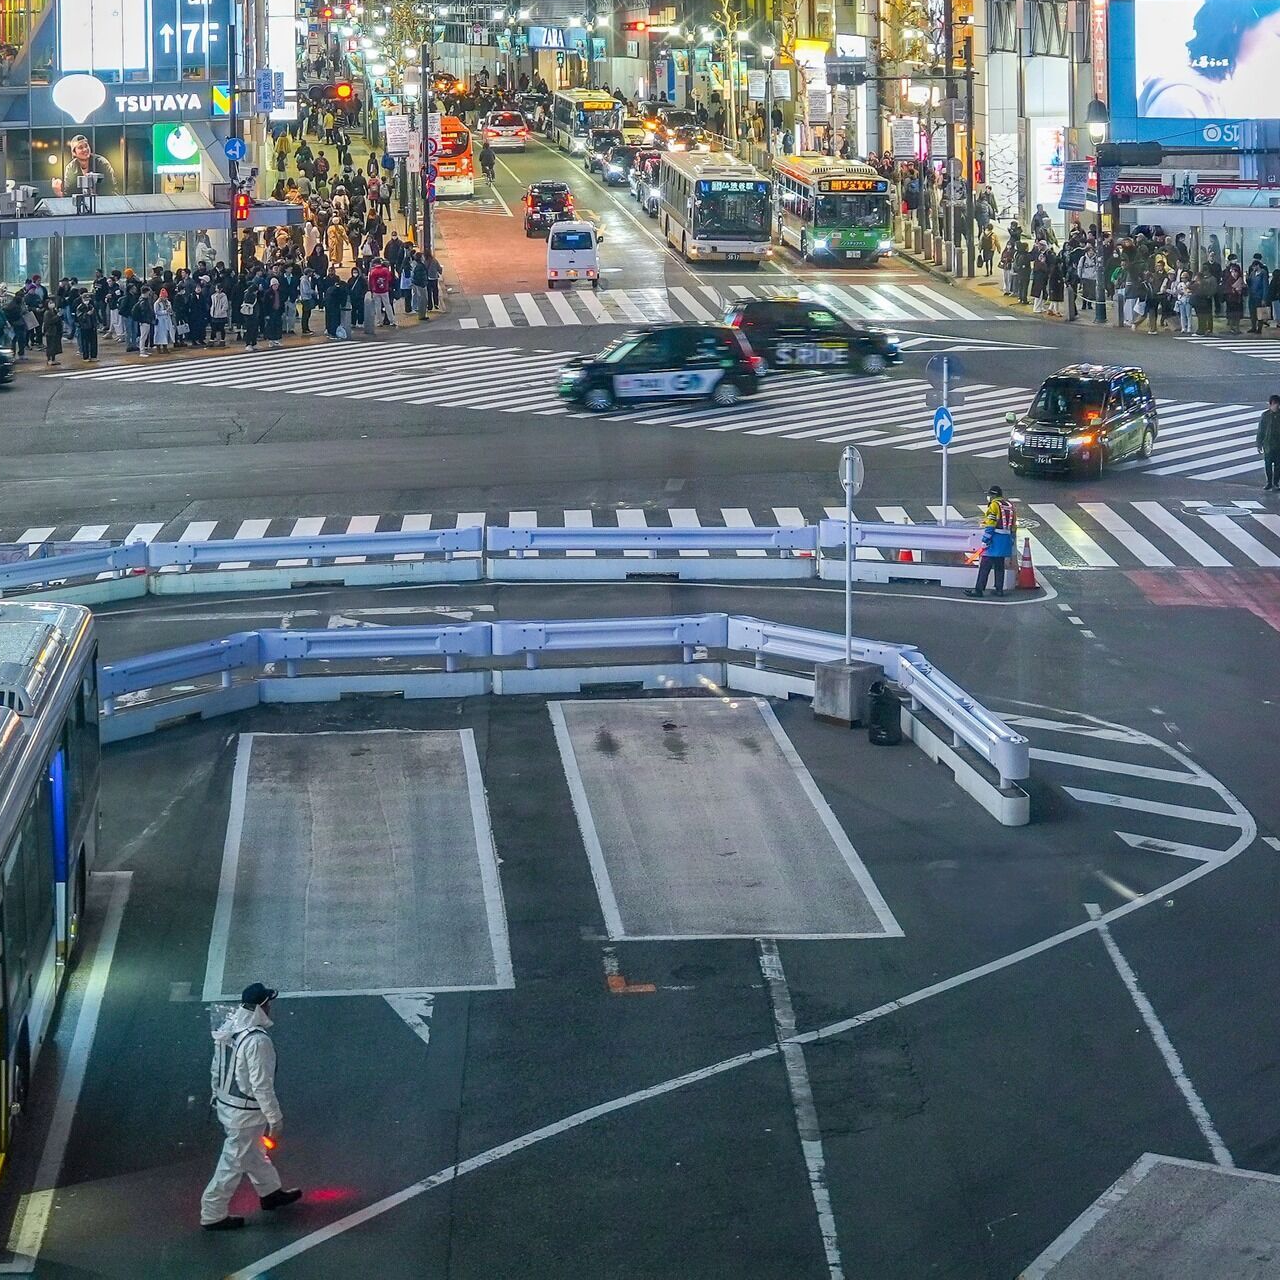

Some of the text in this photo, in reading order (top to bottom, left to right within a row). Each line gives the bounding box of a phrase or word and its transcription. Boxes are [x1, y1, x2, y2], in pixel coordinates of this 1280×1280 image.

[182, 23, 219, 54] 7F
[542, 28, 565, 48] ZARA
[115, 94, 202, 111] TSUTAYA
[1114, 185, 1159, 195] SANZENRI
